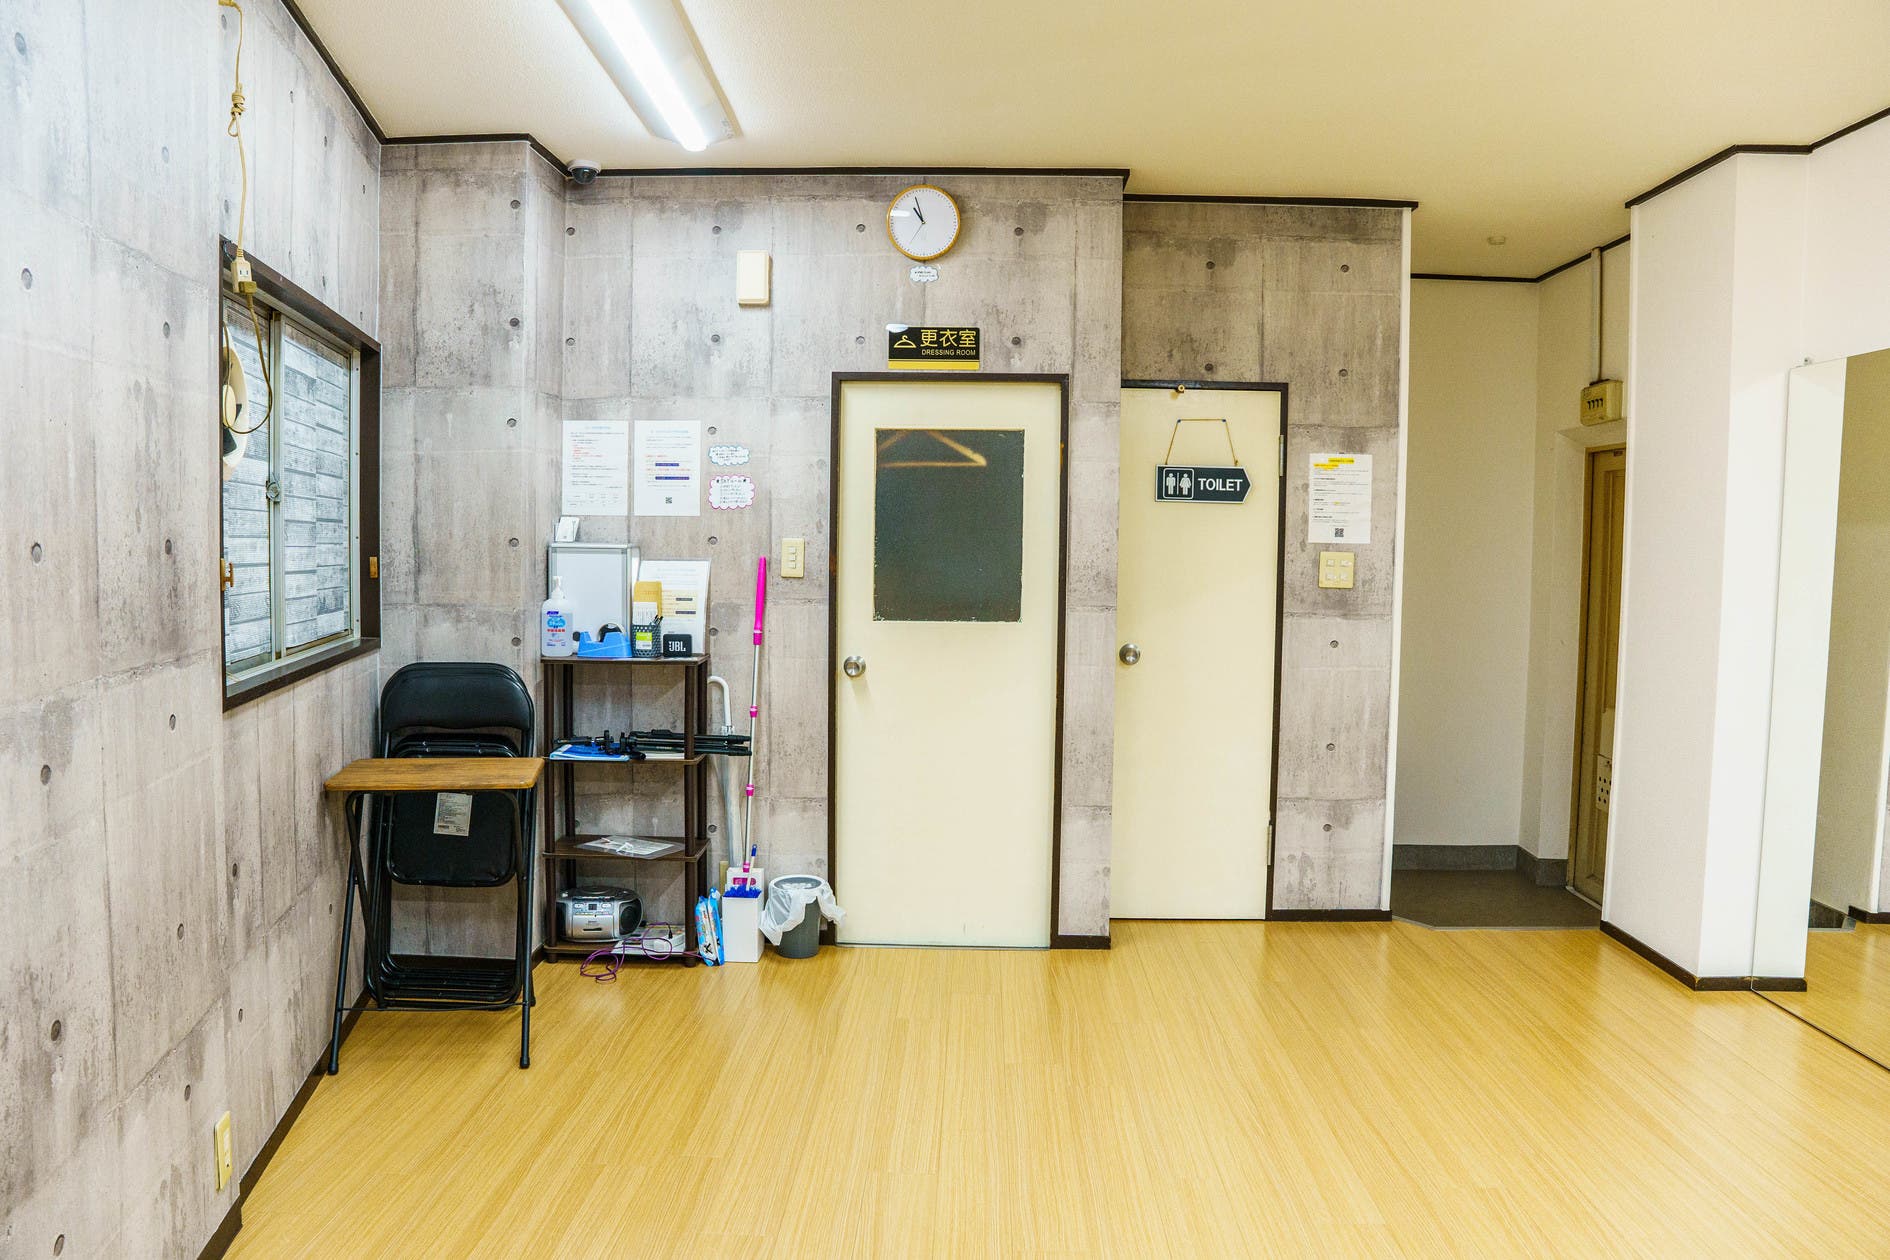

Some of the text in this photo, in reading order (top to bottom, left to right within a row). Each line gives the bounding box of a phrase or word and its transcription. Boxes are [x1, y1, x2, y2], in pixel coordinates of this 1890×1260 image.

[920, 329, 977, 348] 更衣室
[1197, 478, 1243, 492] TOILET
[668, 641, 686, 652] JBL
